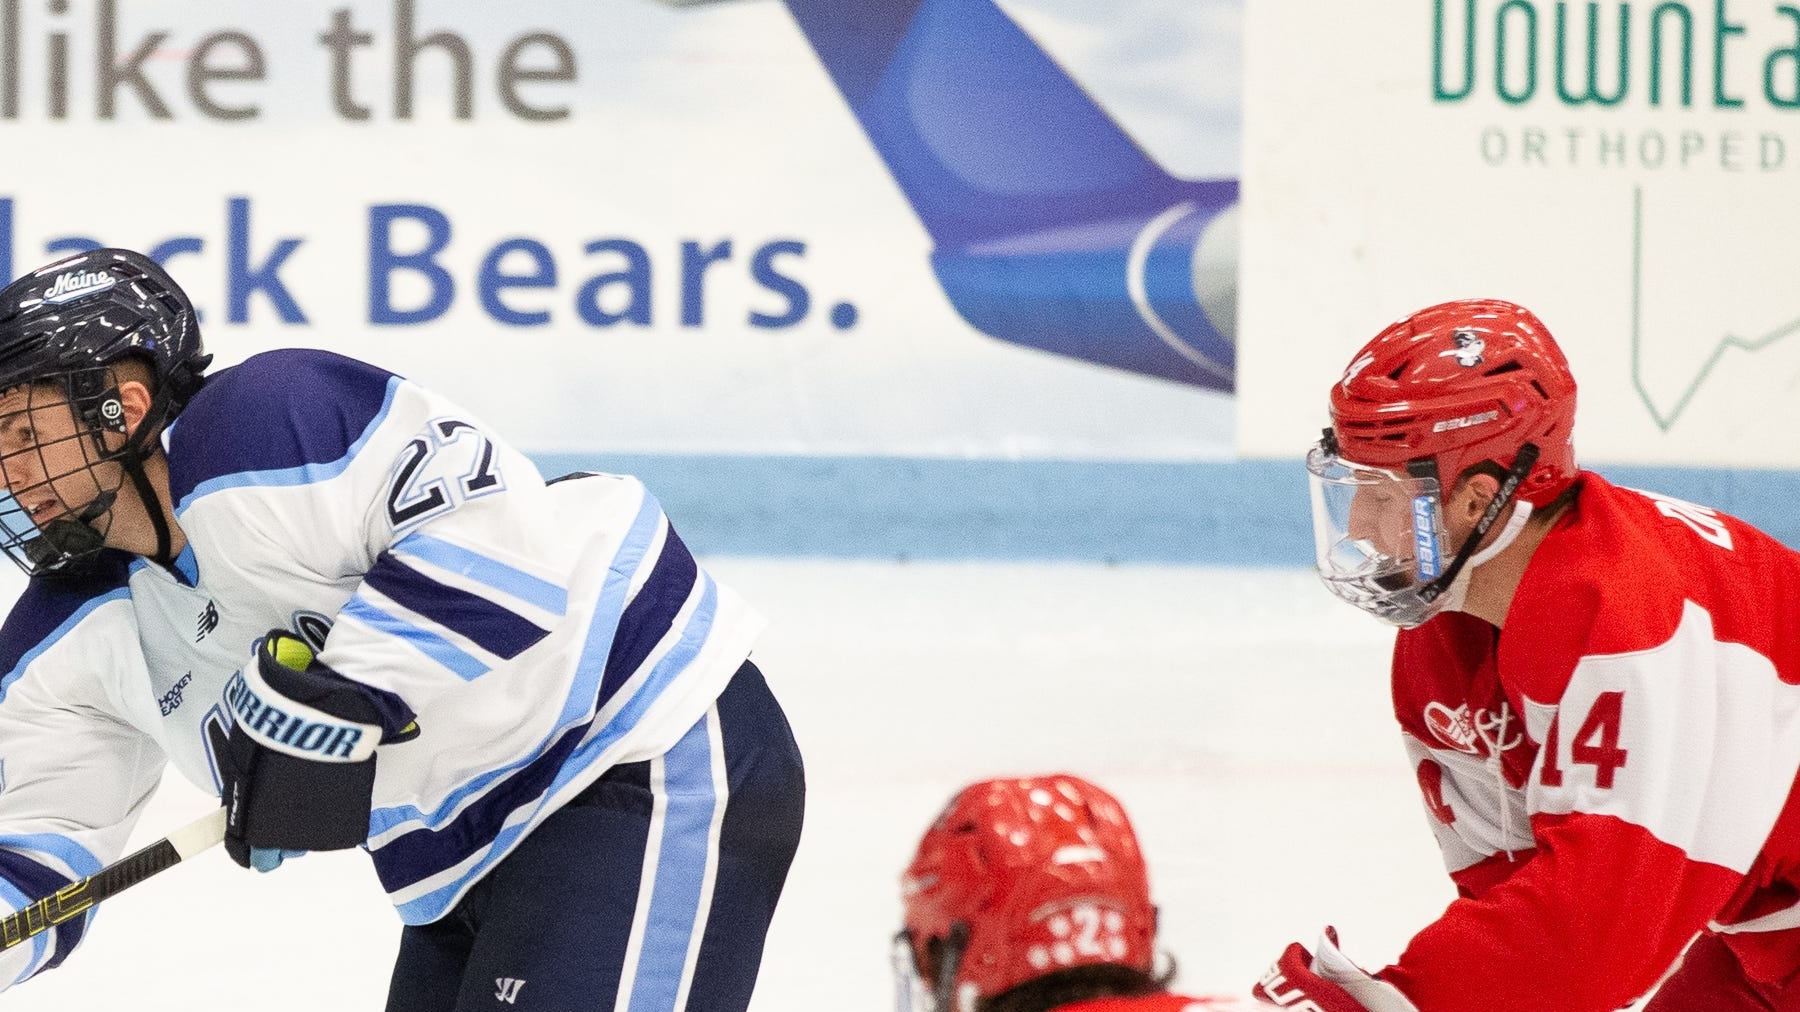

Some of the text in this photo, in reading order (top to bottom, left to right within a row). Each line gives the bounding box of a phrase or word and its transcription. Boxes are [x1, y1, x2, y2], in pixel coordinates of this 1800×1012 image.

[318, 0, 578, 121] the
[1479, 126, 1787, 171] ORTHOPED
[42, 268, 116, 303] Maine
[367, 203, 860, 330] Bears.
[1433, 410, 1499, 433] BAUER
[384, 416, 507, 535] 27
[157, 669, 192, 708] HOCKEY
[160, 691, 183, 717] EAST
[234, 677, 364, 759] ARRIOR
[1540, 691, 1628, 790] 14
